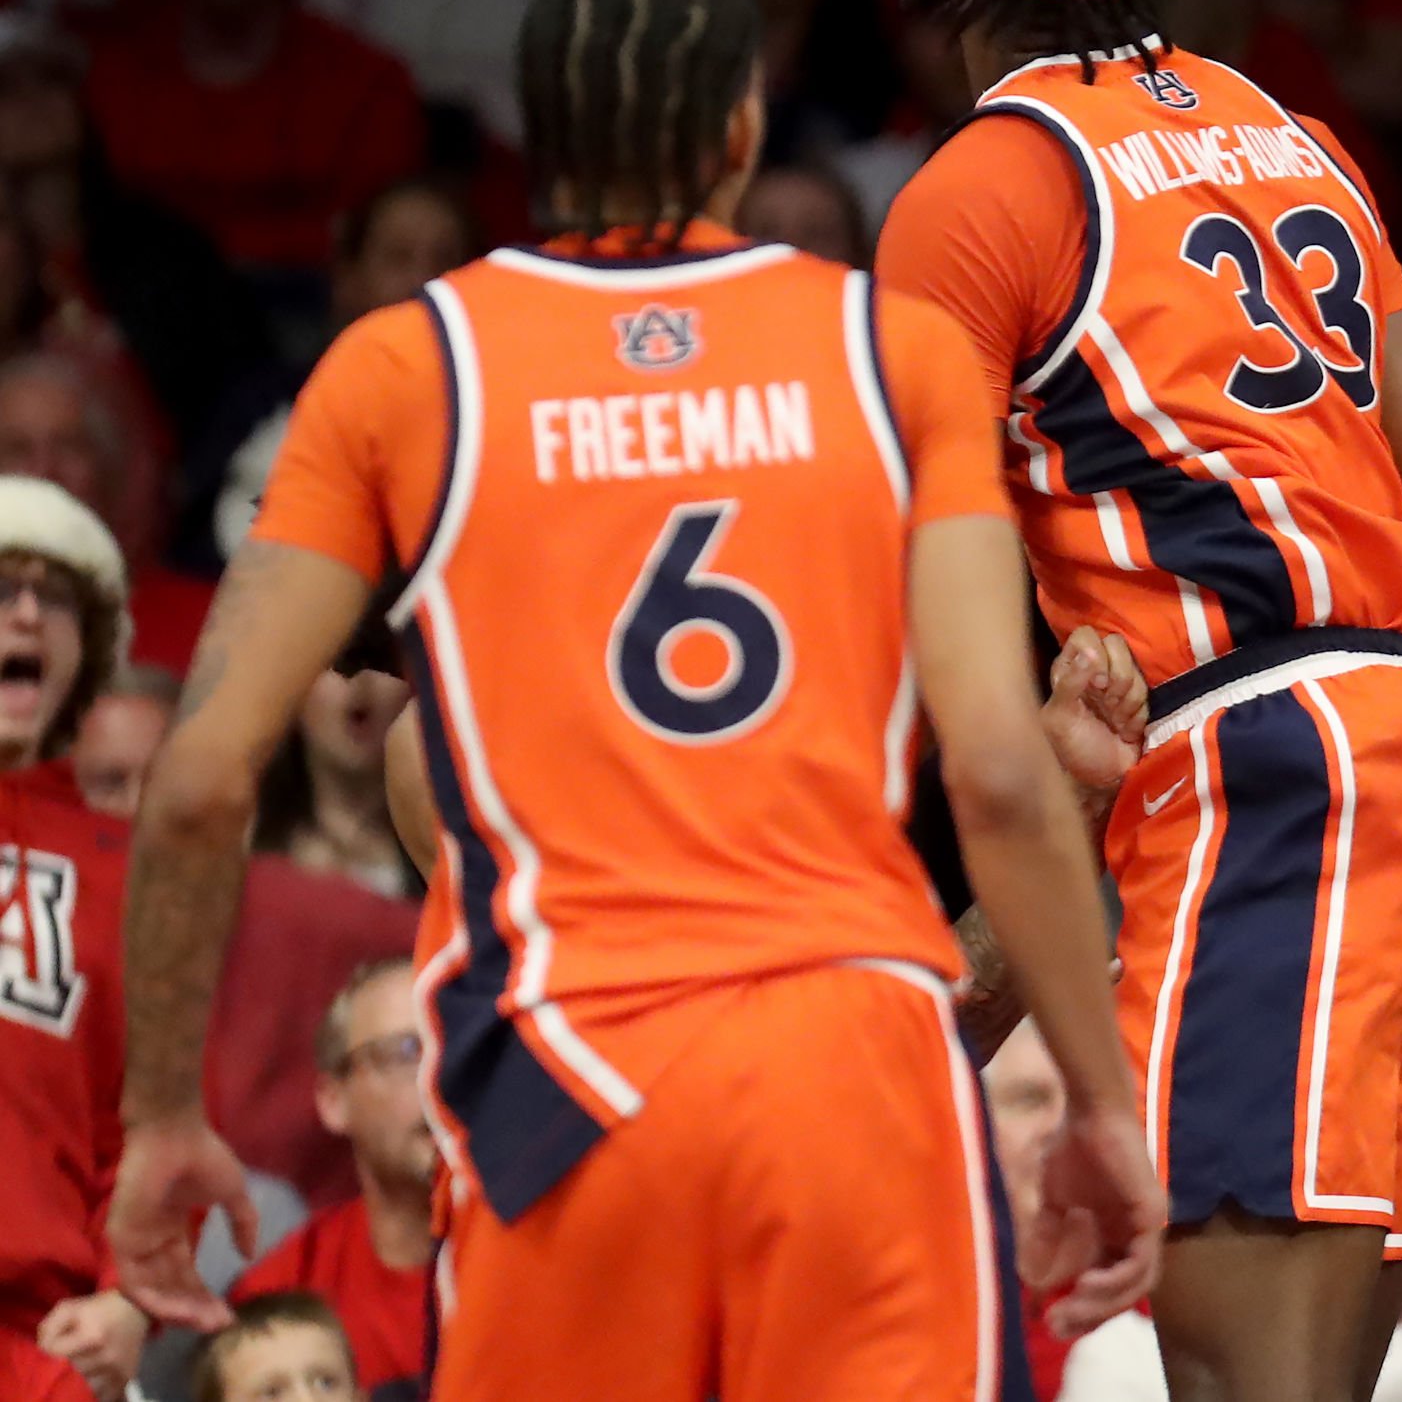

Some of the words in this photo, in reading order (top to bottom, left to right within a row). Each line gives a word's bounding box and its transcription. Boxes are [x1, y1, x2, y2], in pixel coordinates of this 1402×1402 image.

[1179, 204, 1377, 413] 33
[530, 381, 814, 484] FREEMAN
[605, 498, 794, 746] 6
